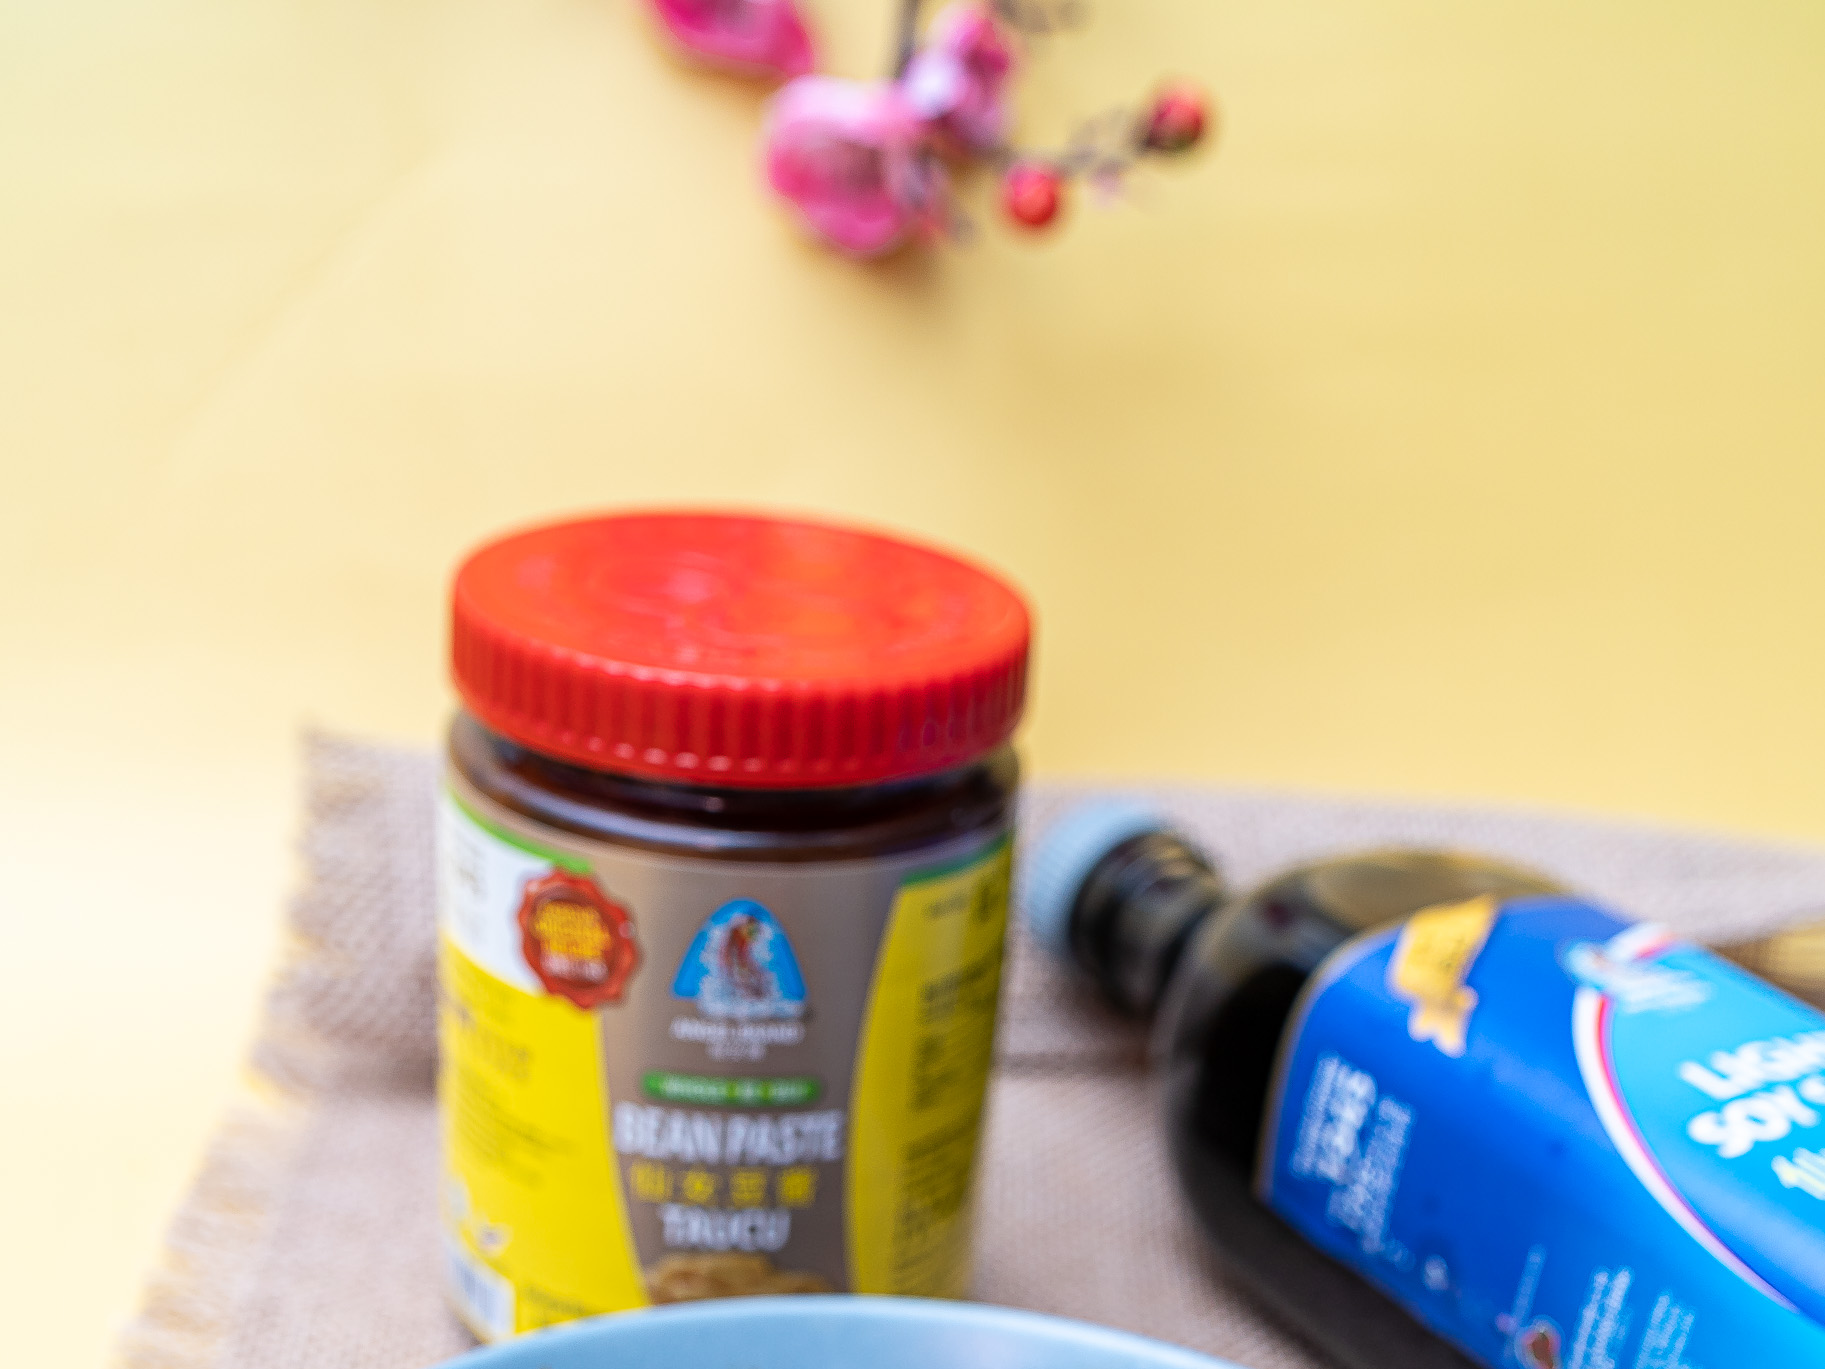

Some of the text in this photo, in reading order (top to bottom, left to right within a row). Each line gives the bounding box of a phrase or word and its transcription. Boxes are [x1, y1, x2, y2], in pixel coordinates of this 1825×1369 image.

[1679, 1032, 1825, 1100] LIGH
[613, 1101, 845, 1166] BEAN PASTE
[1687, 1083, 1819, 1159] SOY
